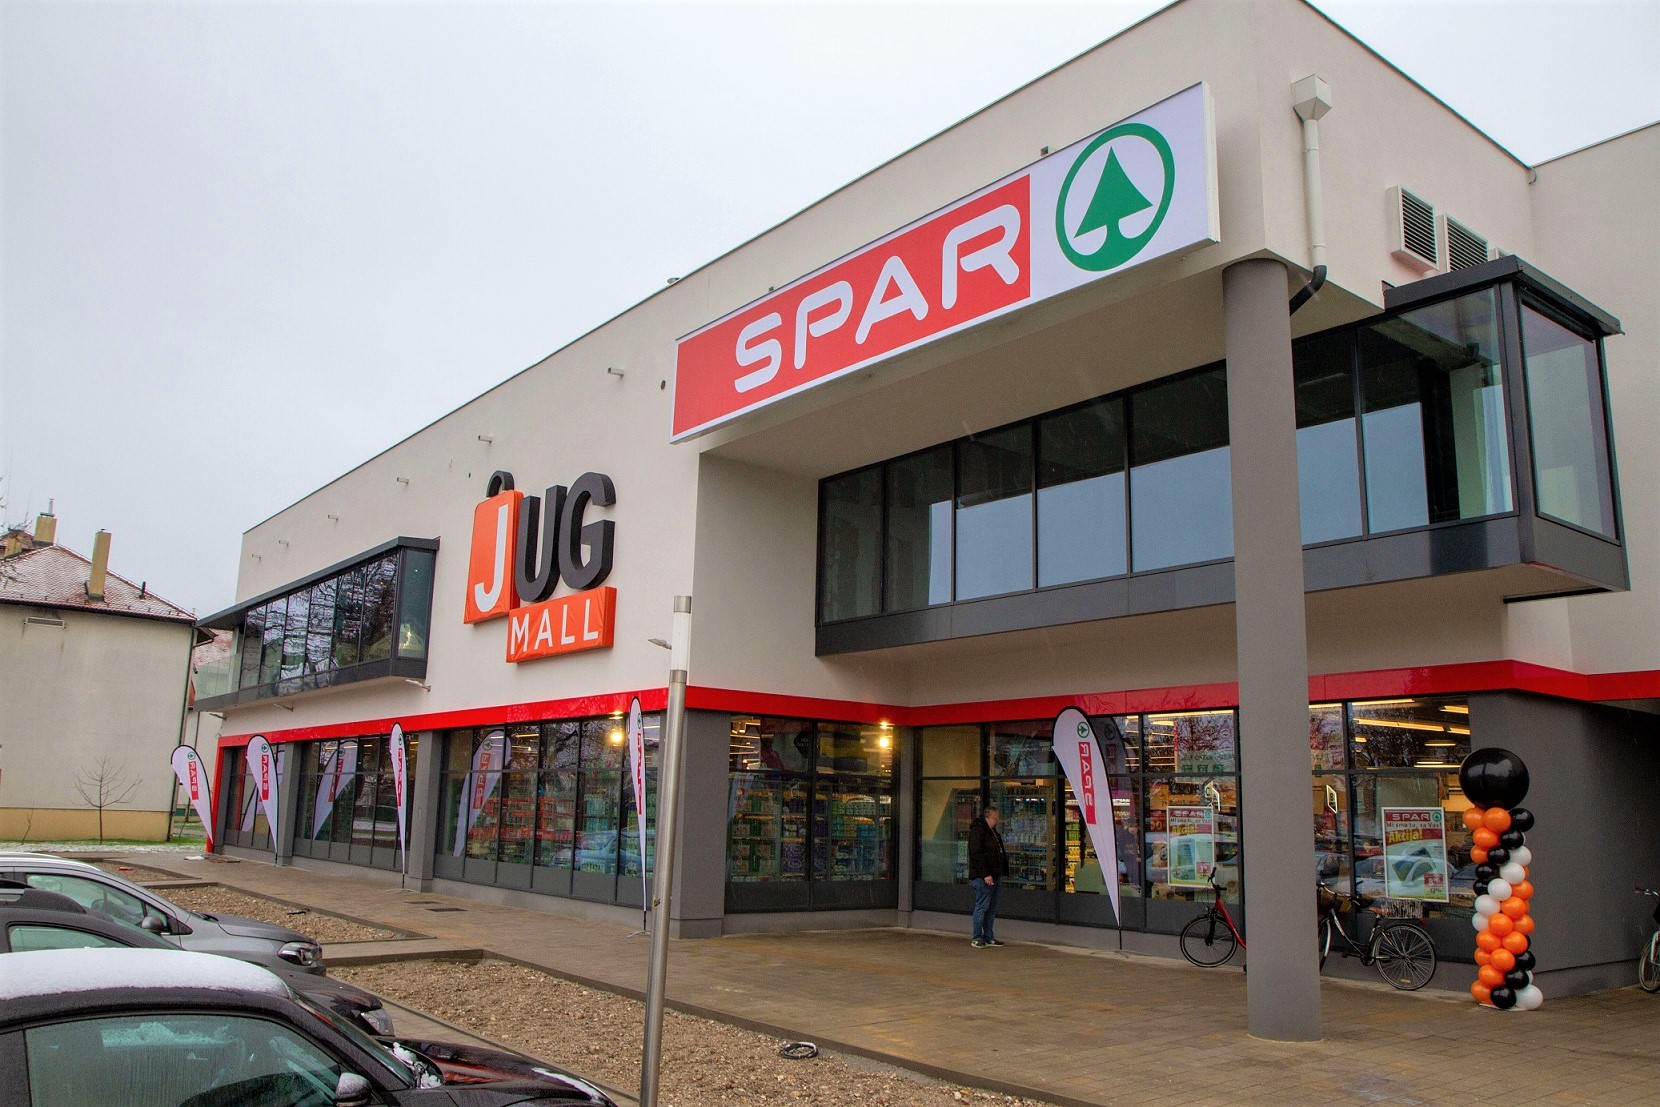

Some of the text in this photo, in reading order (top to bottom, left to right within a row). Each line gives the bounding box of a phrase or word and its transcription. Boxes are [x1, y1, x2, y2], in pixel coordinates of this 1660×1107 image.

[734, 204, 1021, 393] SPAR
[474, 472, 616, 613] JUG
[510, 599, 599, 655] MALL
[1388, 828, 1423, 843] Akcija!
[1391, 813, 1430, 821] SPAR
